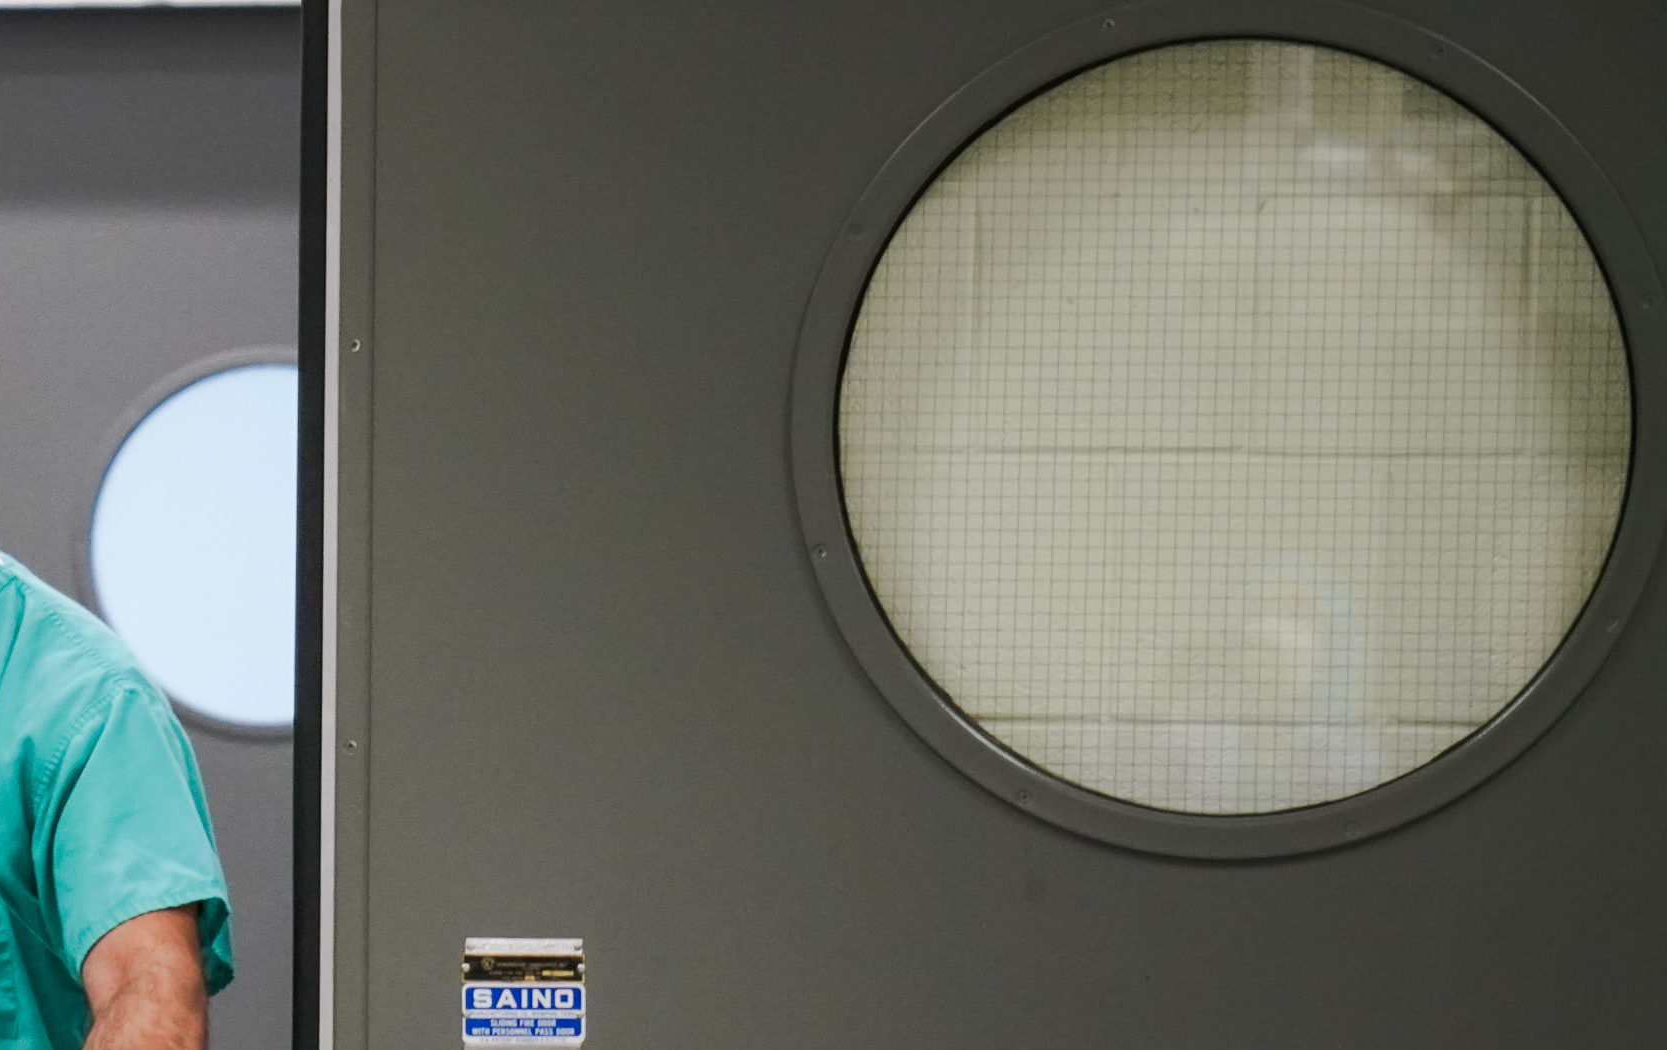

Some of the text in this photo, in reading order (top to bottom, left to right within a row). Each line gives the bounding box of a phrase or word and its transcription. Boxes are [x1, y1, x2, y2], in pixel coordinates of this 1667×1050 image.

[473, 990, 574, 1009] SAINO
[519, 1018, 535, 1028] FIRE
[535, 1027, 554, 1037] PASS
